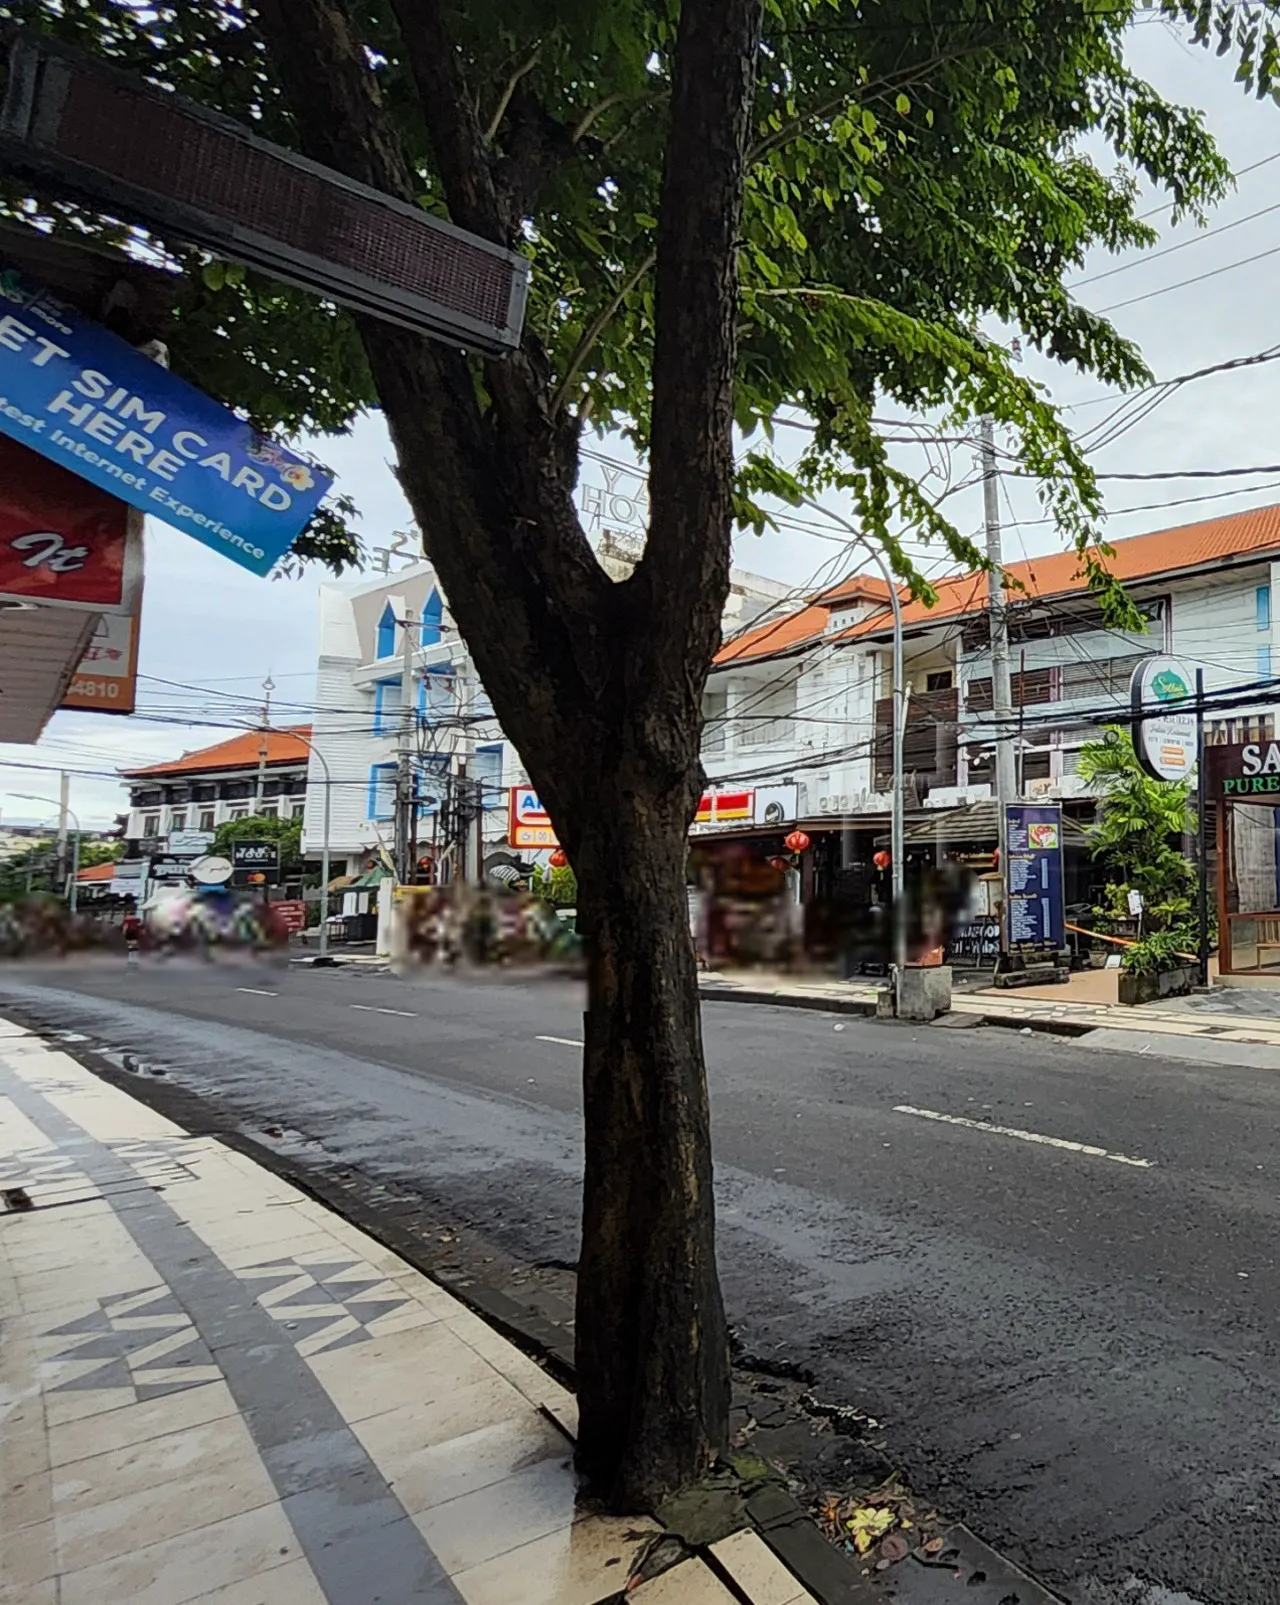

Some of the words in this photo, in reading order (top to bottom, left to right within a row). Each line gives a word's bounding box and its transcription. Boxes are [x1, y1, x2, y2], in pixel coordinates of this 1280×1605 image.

[0, 315, 71, 367] ET
[71, 369, 166, 433] SIM
[172, 431, 292, 511] CARD
[47, 390, 186, 481] HERE
[50, 430, 148, 491] Internet
[149, 486, 265, 560] Experience
[1222, 776, 1280, 795] PURE
